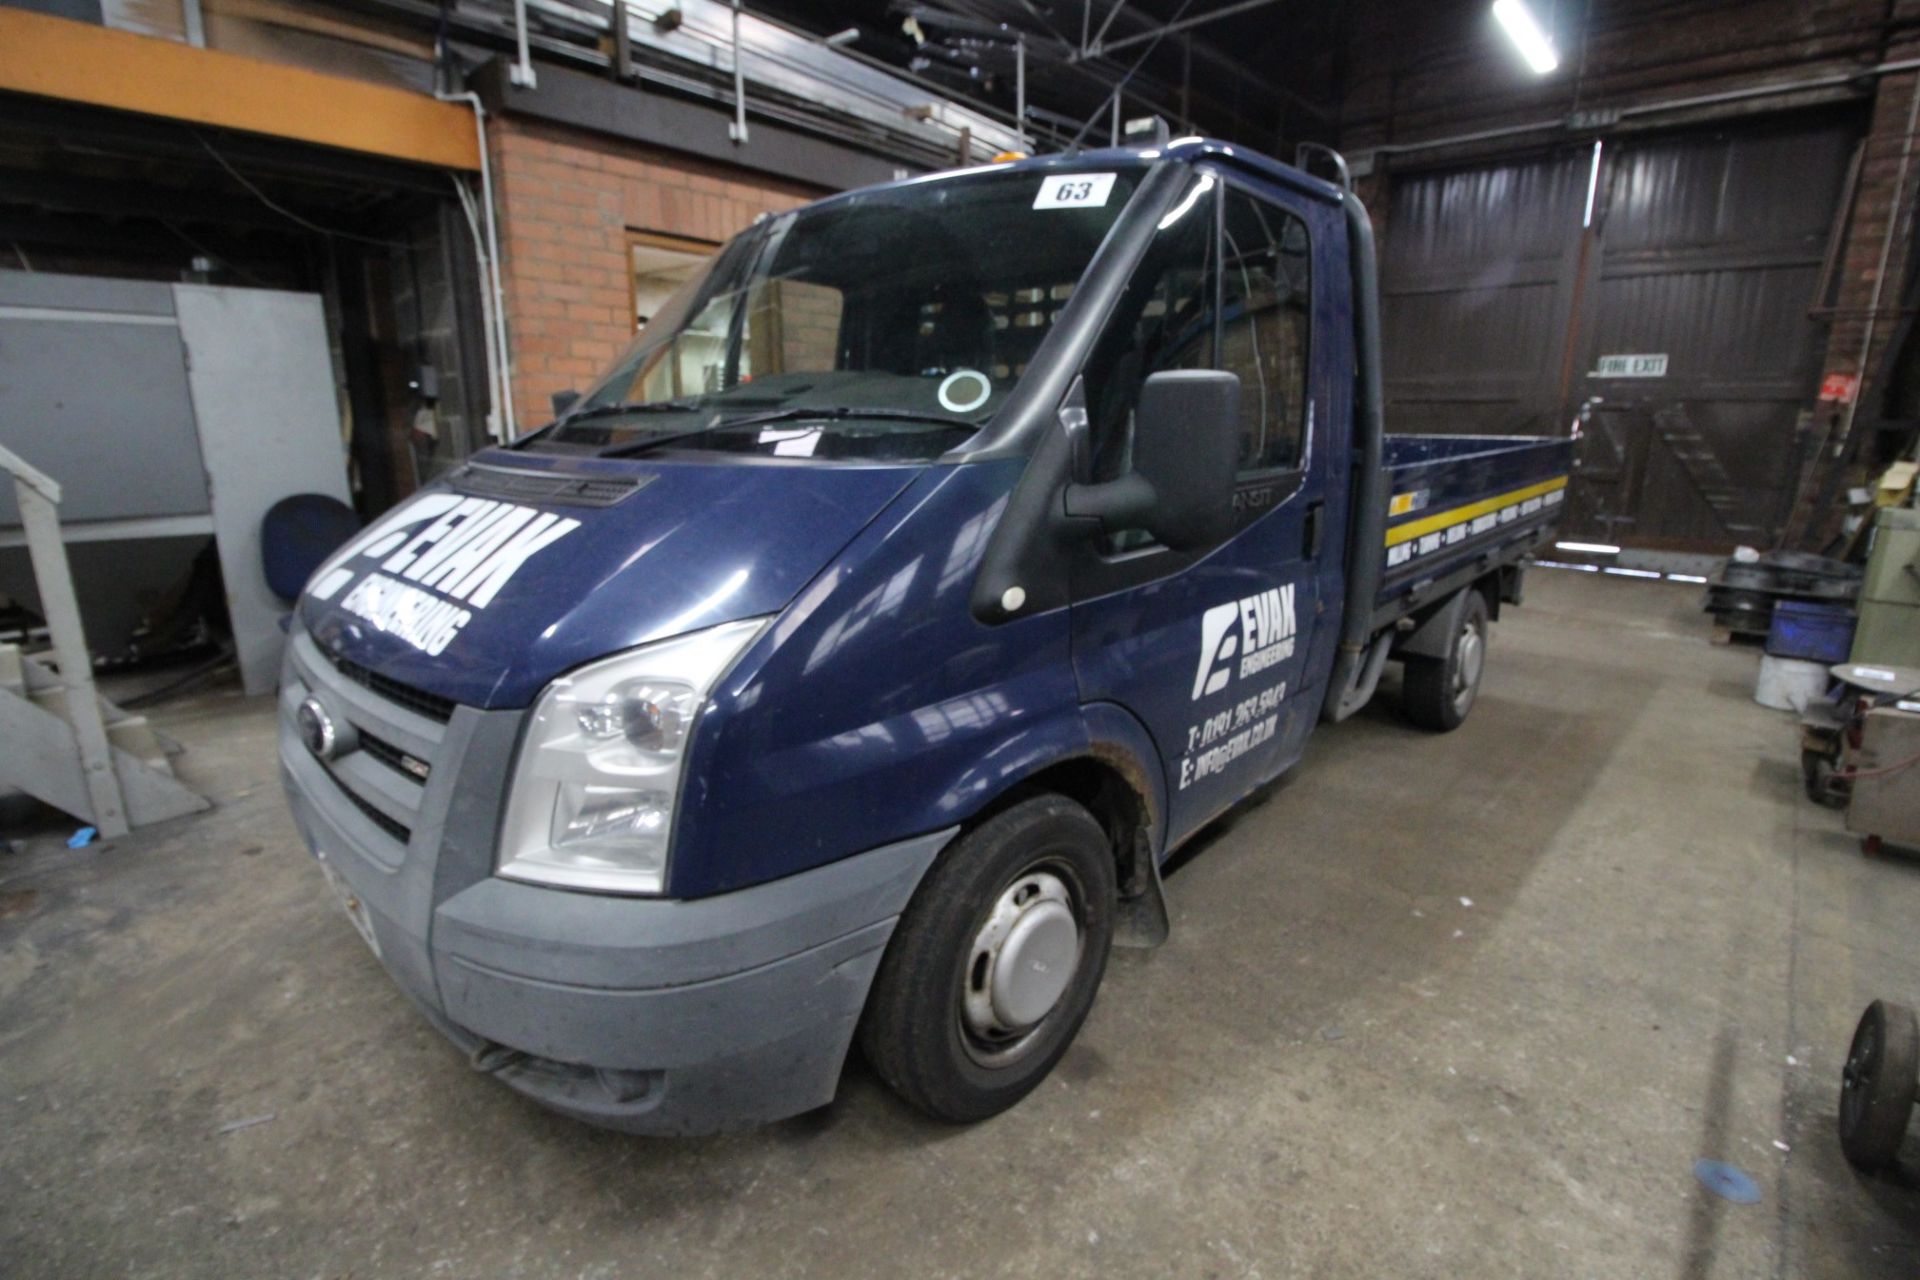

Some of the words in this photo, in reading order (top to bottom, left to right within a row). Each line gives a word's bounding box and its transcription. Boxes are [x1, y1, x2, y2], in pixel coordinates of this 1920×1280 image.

[1056, 182, 1093, 201] 63
[1633, 358, 1663, 373] EXIT
[381, 497, 582, 609] EVAK
[1238, 583, 1297, 655] EVAK
[1239, 636, 1295, 680] ENGINEERING
